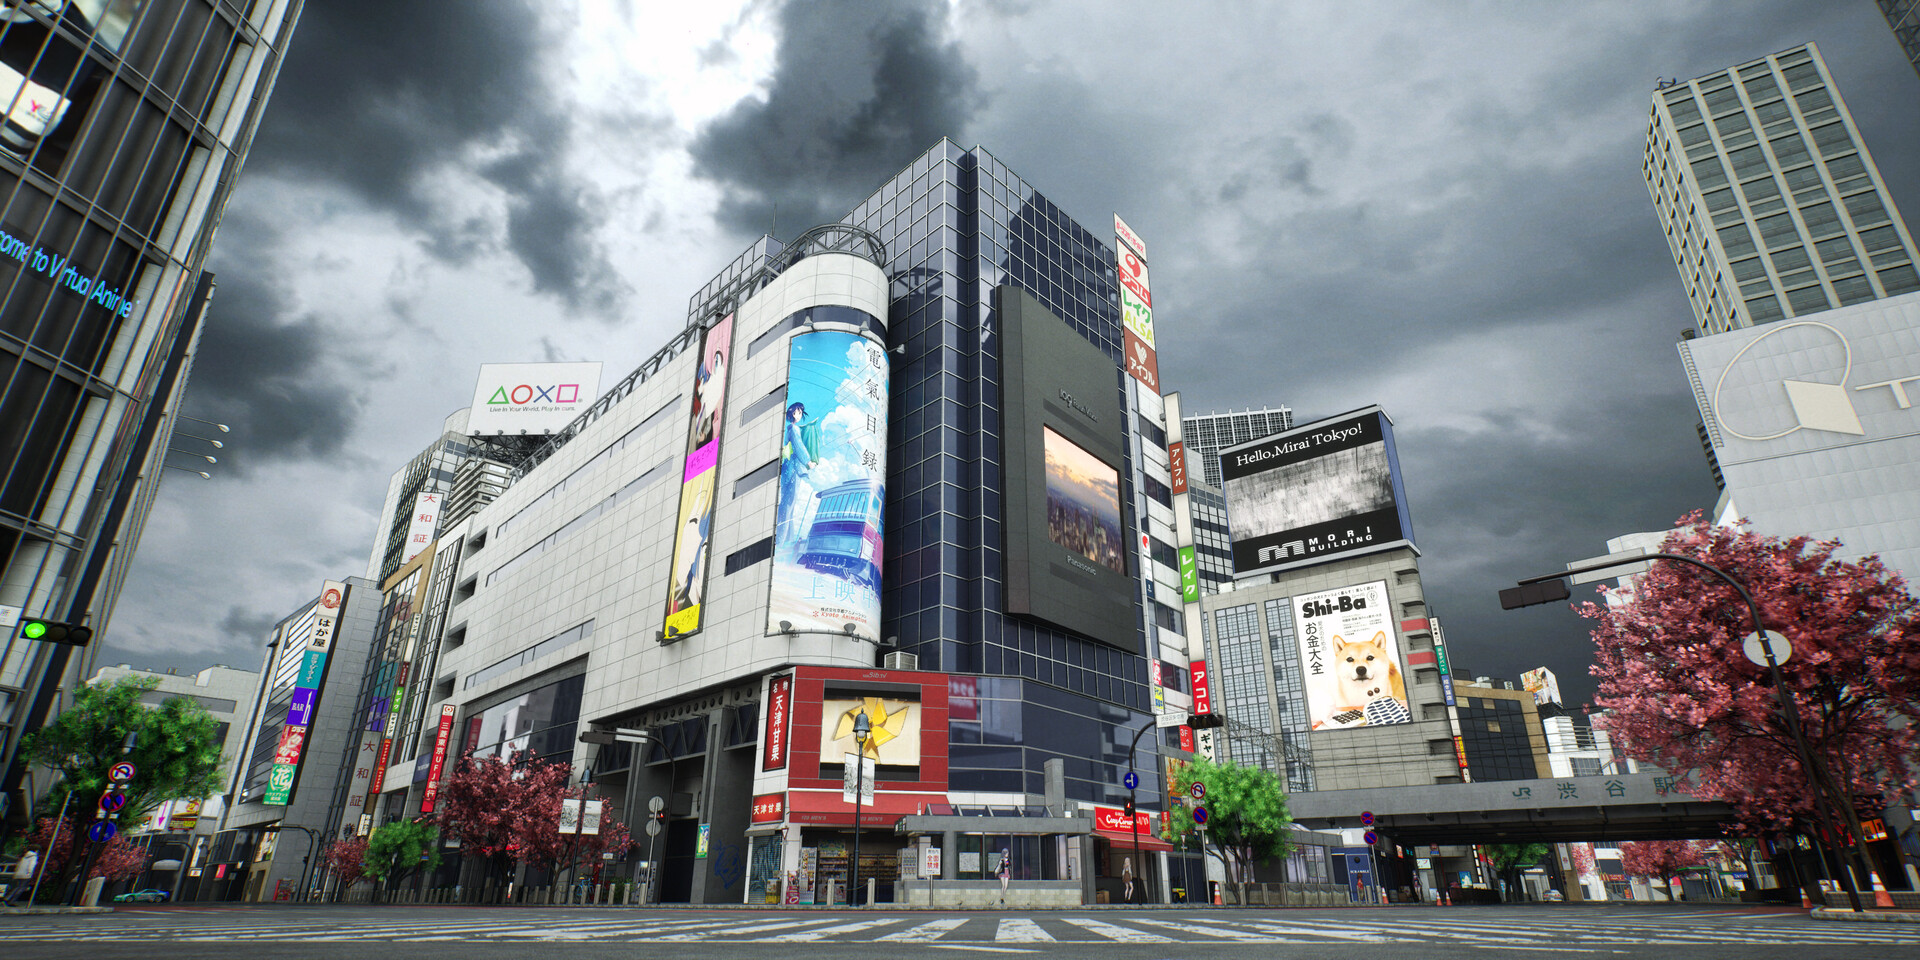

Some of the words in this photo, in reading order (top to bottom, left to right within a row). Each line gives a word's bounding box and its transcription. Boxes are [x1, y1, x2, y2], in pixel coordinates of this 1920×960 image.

[31, 247, 49, 272] to
[49, 253, 95, 296] Vrtual
[1121, 269, 1149, 304] アコム
[1122, 288, 1151, 324] レイク
[1124, 310, 1154, 345] ALSA
[1129, 356, 1155, 386] アイフル
[1311, 422, 1363, 446] Tokyo!
[1171, 448, 1184, 487] アイフル
[1308, 526, 1371, 546] MORI
[1310, 534, 1373, 552] BUILDING
[1066, 555, 1097, 576] Panasonic
[1181, 554, 1196, 595] レイク
[803, 577, 875, 608] 上映中
[1302, 595, 1367, 619] Shi-Ba
[312, 618, 331, 648] はが屋
[841, 613, 867, 624] Animation
[1305, 622, 1324, 676] お金大全
[393, 690, 402, 710] レイク
[1193, 670, 1208, 713] アコム
[291, 702, 304, 712] BAR
[770, 694, 783, 762] 天津甘栗
[350, 740, 376, 806] 大和証
[425, 722, 449, 799] 三菱東京UFJ銀行
[273, 766, 291, 787] 花
[1512, 787, 1531, 797] JR
[753, 801, 782, 815] 天津甘栗
